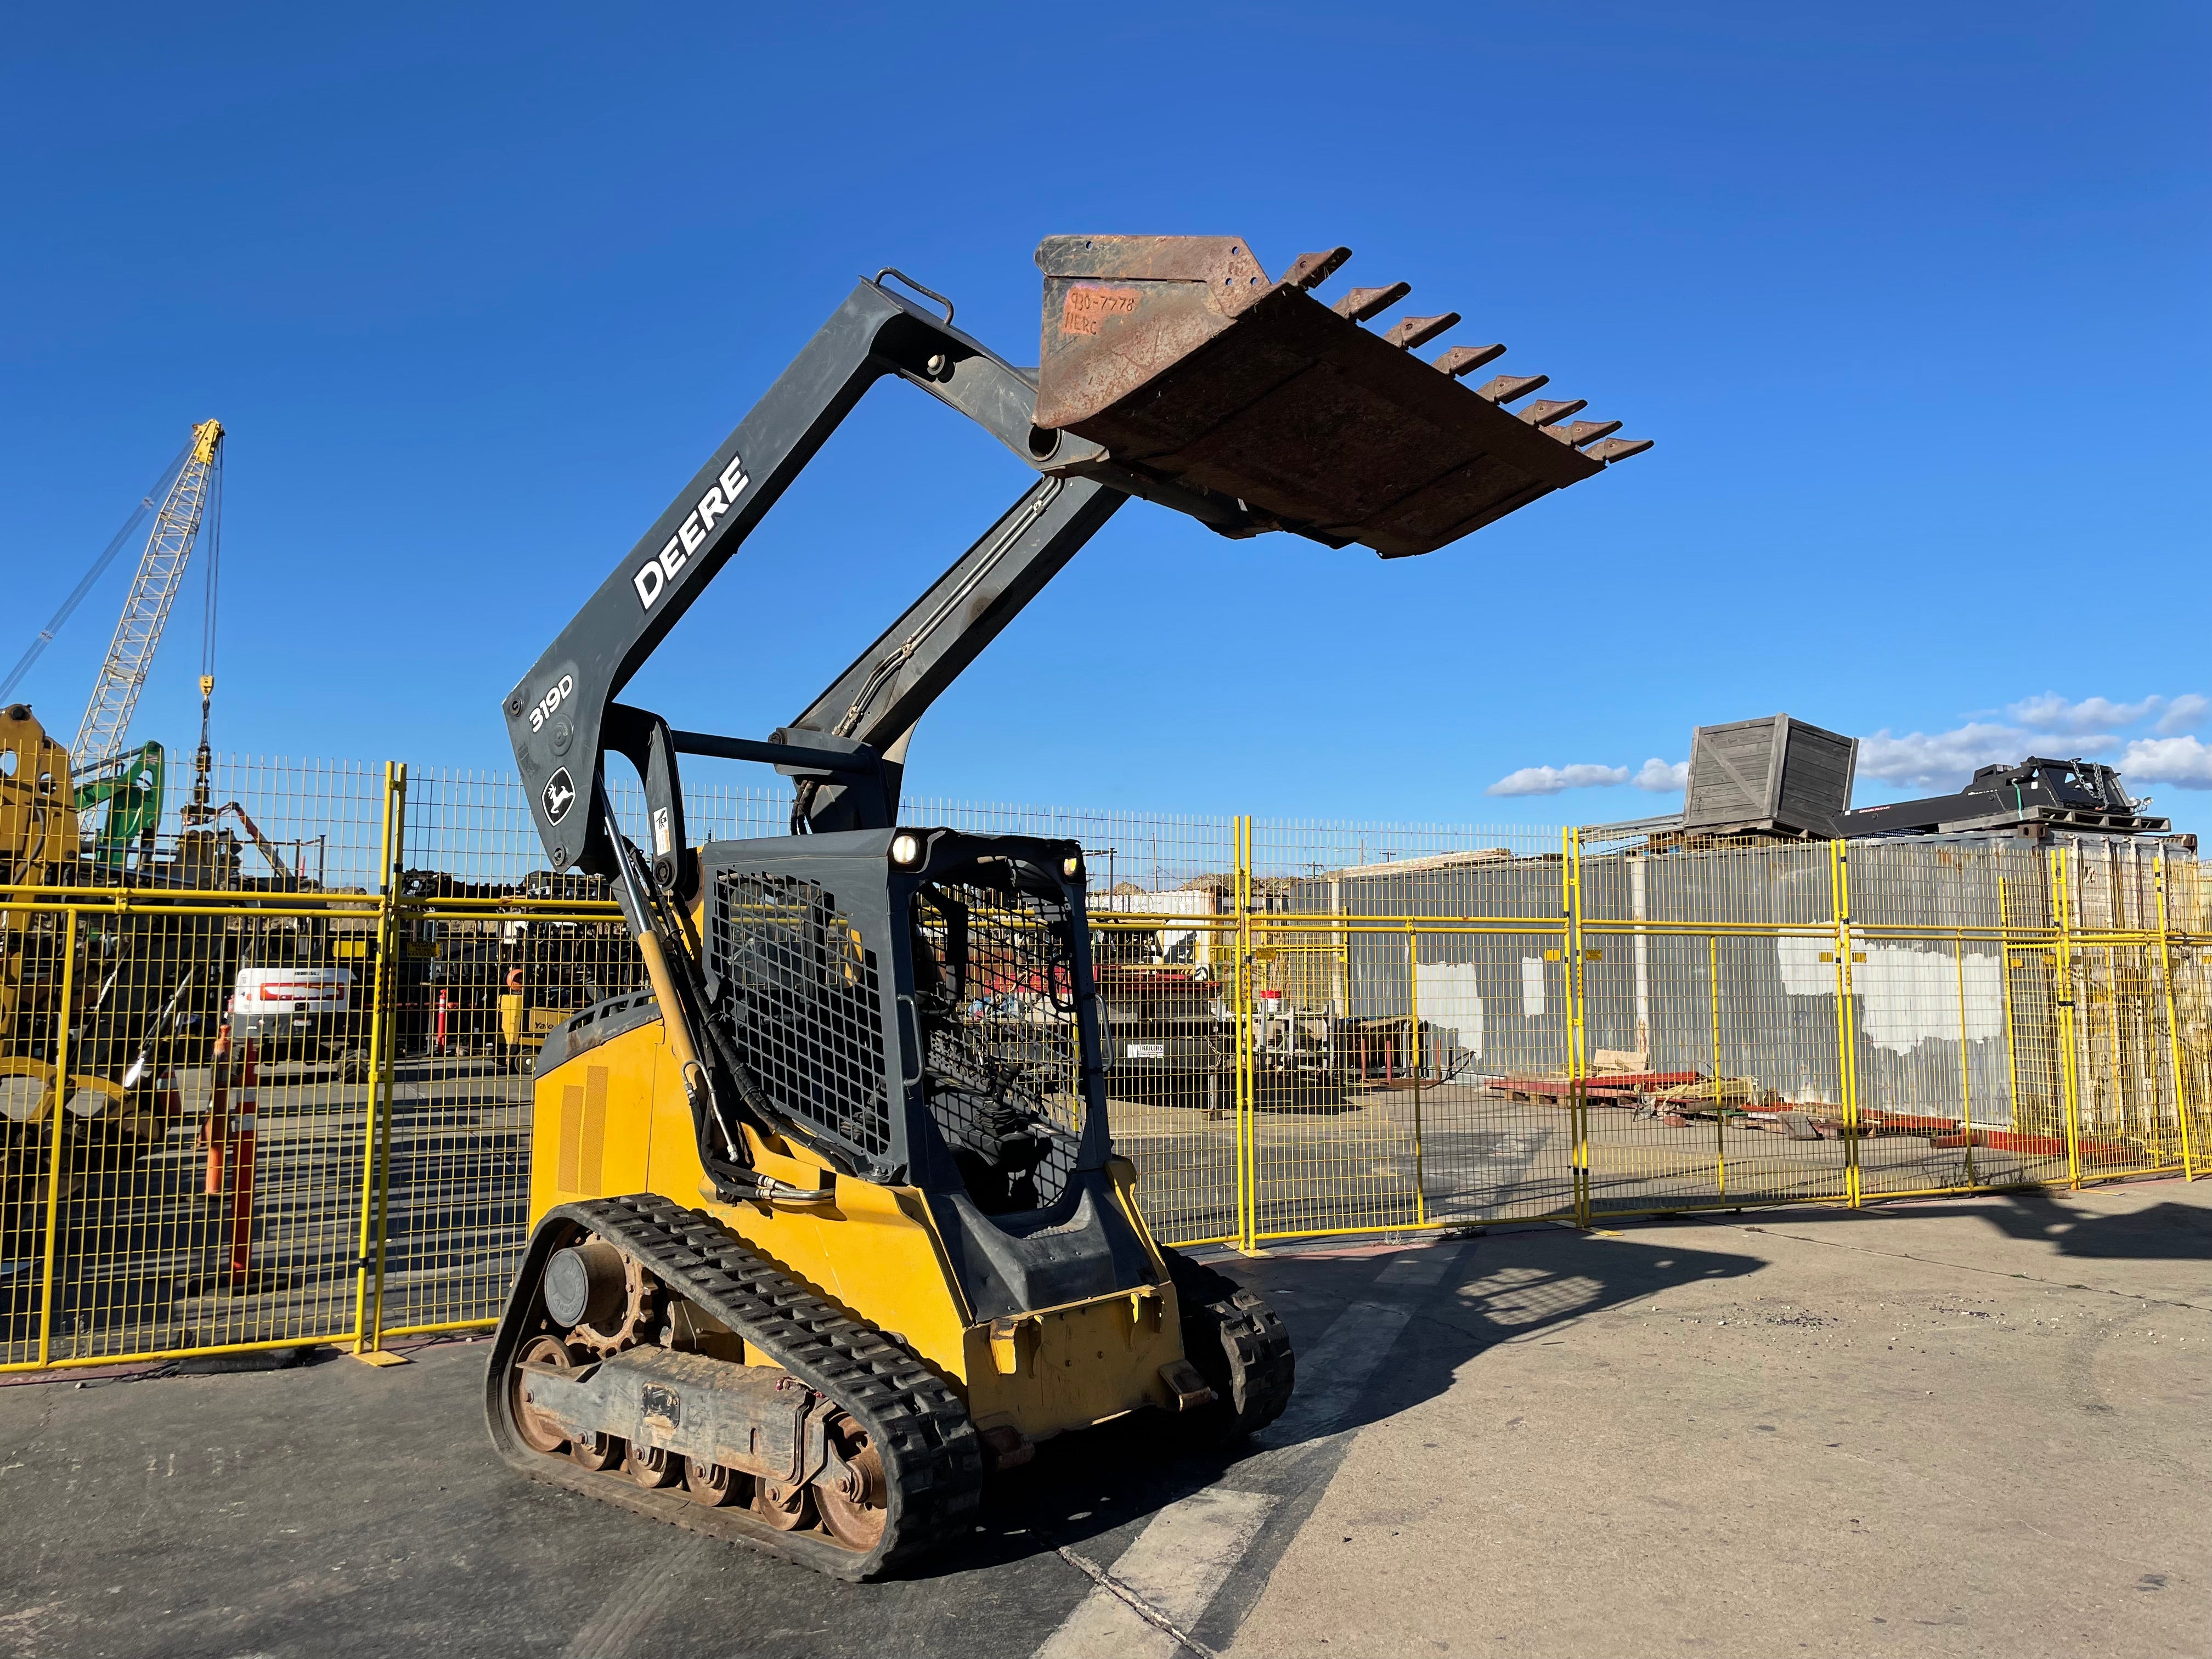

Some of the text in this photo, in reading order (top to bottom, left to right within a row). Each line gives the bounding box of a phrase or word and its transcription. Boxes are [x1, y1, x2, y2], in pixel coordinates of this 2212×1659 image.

[1071, 292, 1135, 312] 930-7778
[633, 455, 749, 611] DEERE
[529, 674, 573, 733] 319D
